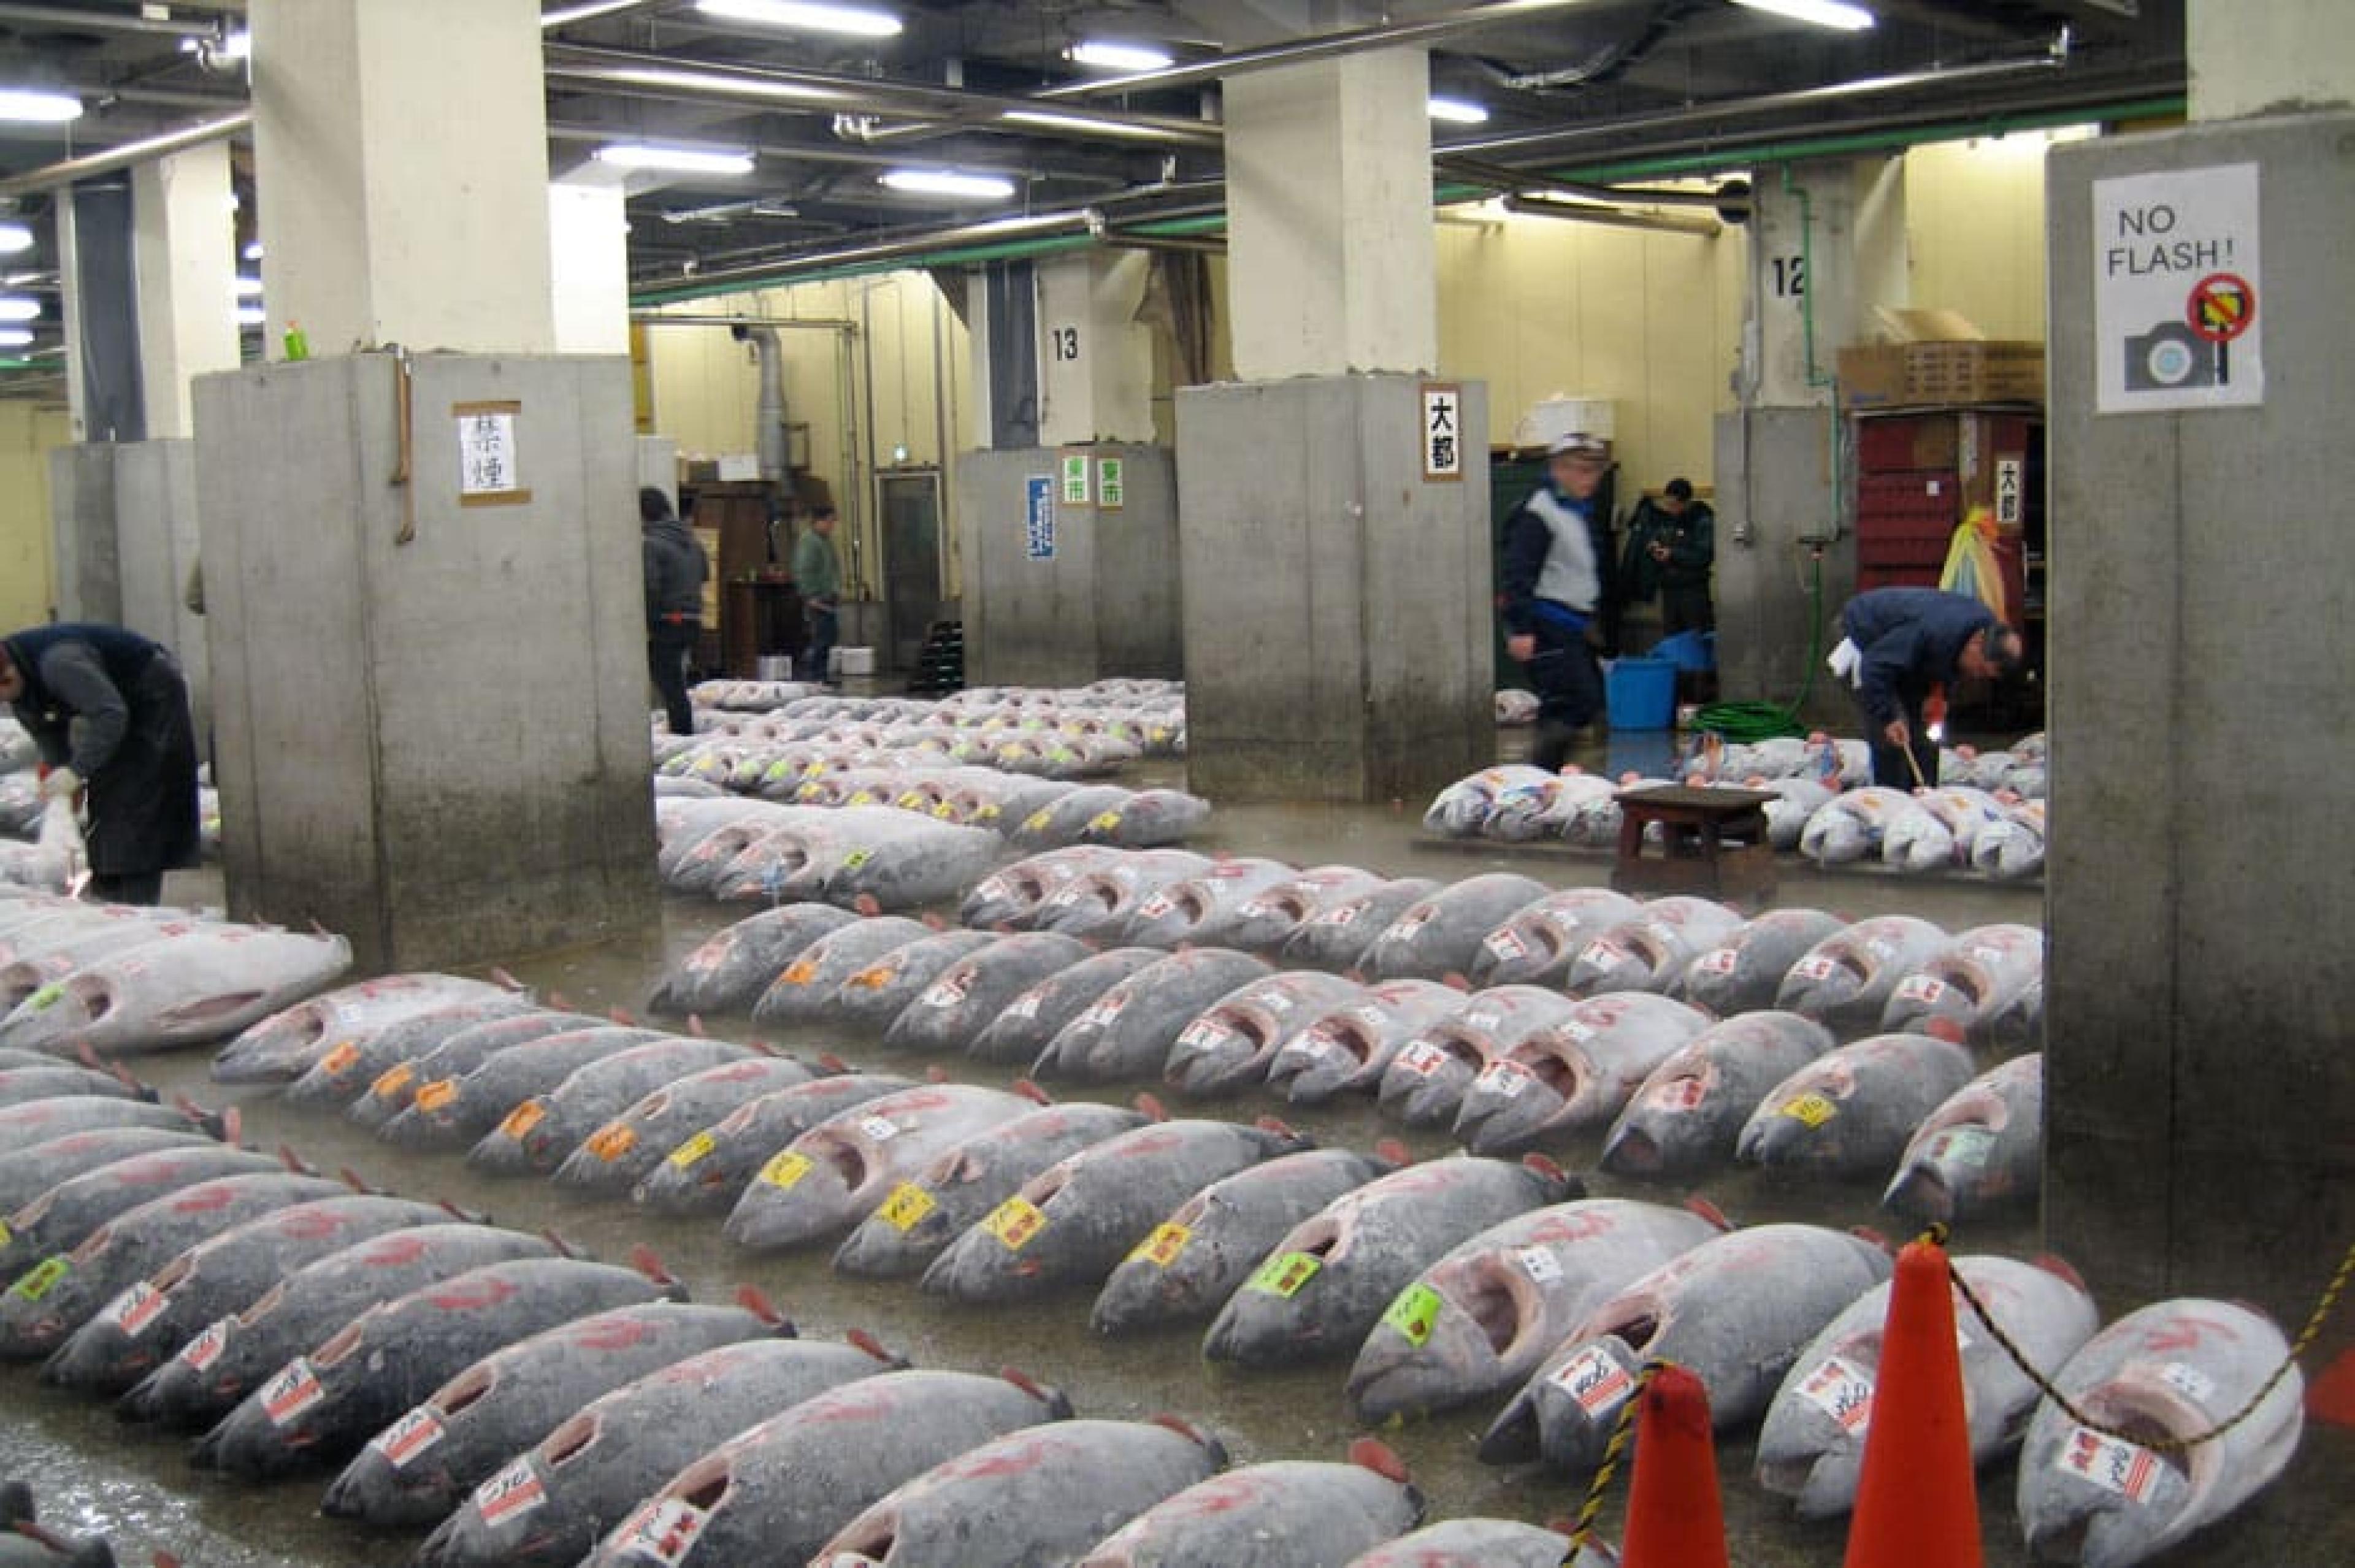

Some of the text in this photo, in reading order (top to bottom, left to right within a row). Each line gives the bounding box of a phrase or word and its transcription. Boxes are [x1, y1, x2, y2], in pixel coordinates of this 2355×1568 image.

[2119, 204, 2177, 237] NO
[1771, 256, 1806, 297] 12
[2108, 237, 2234, 278] FLASH!
[1052, 327, 1078, 361] 13
[1430, 396, 1455, 470] 大都
